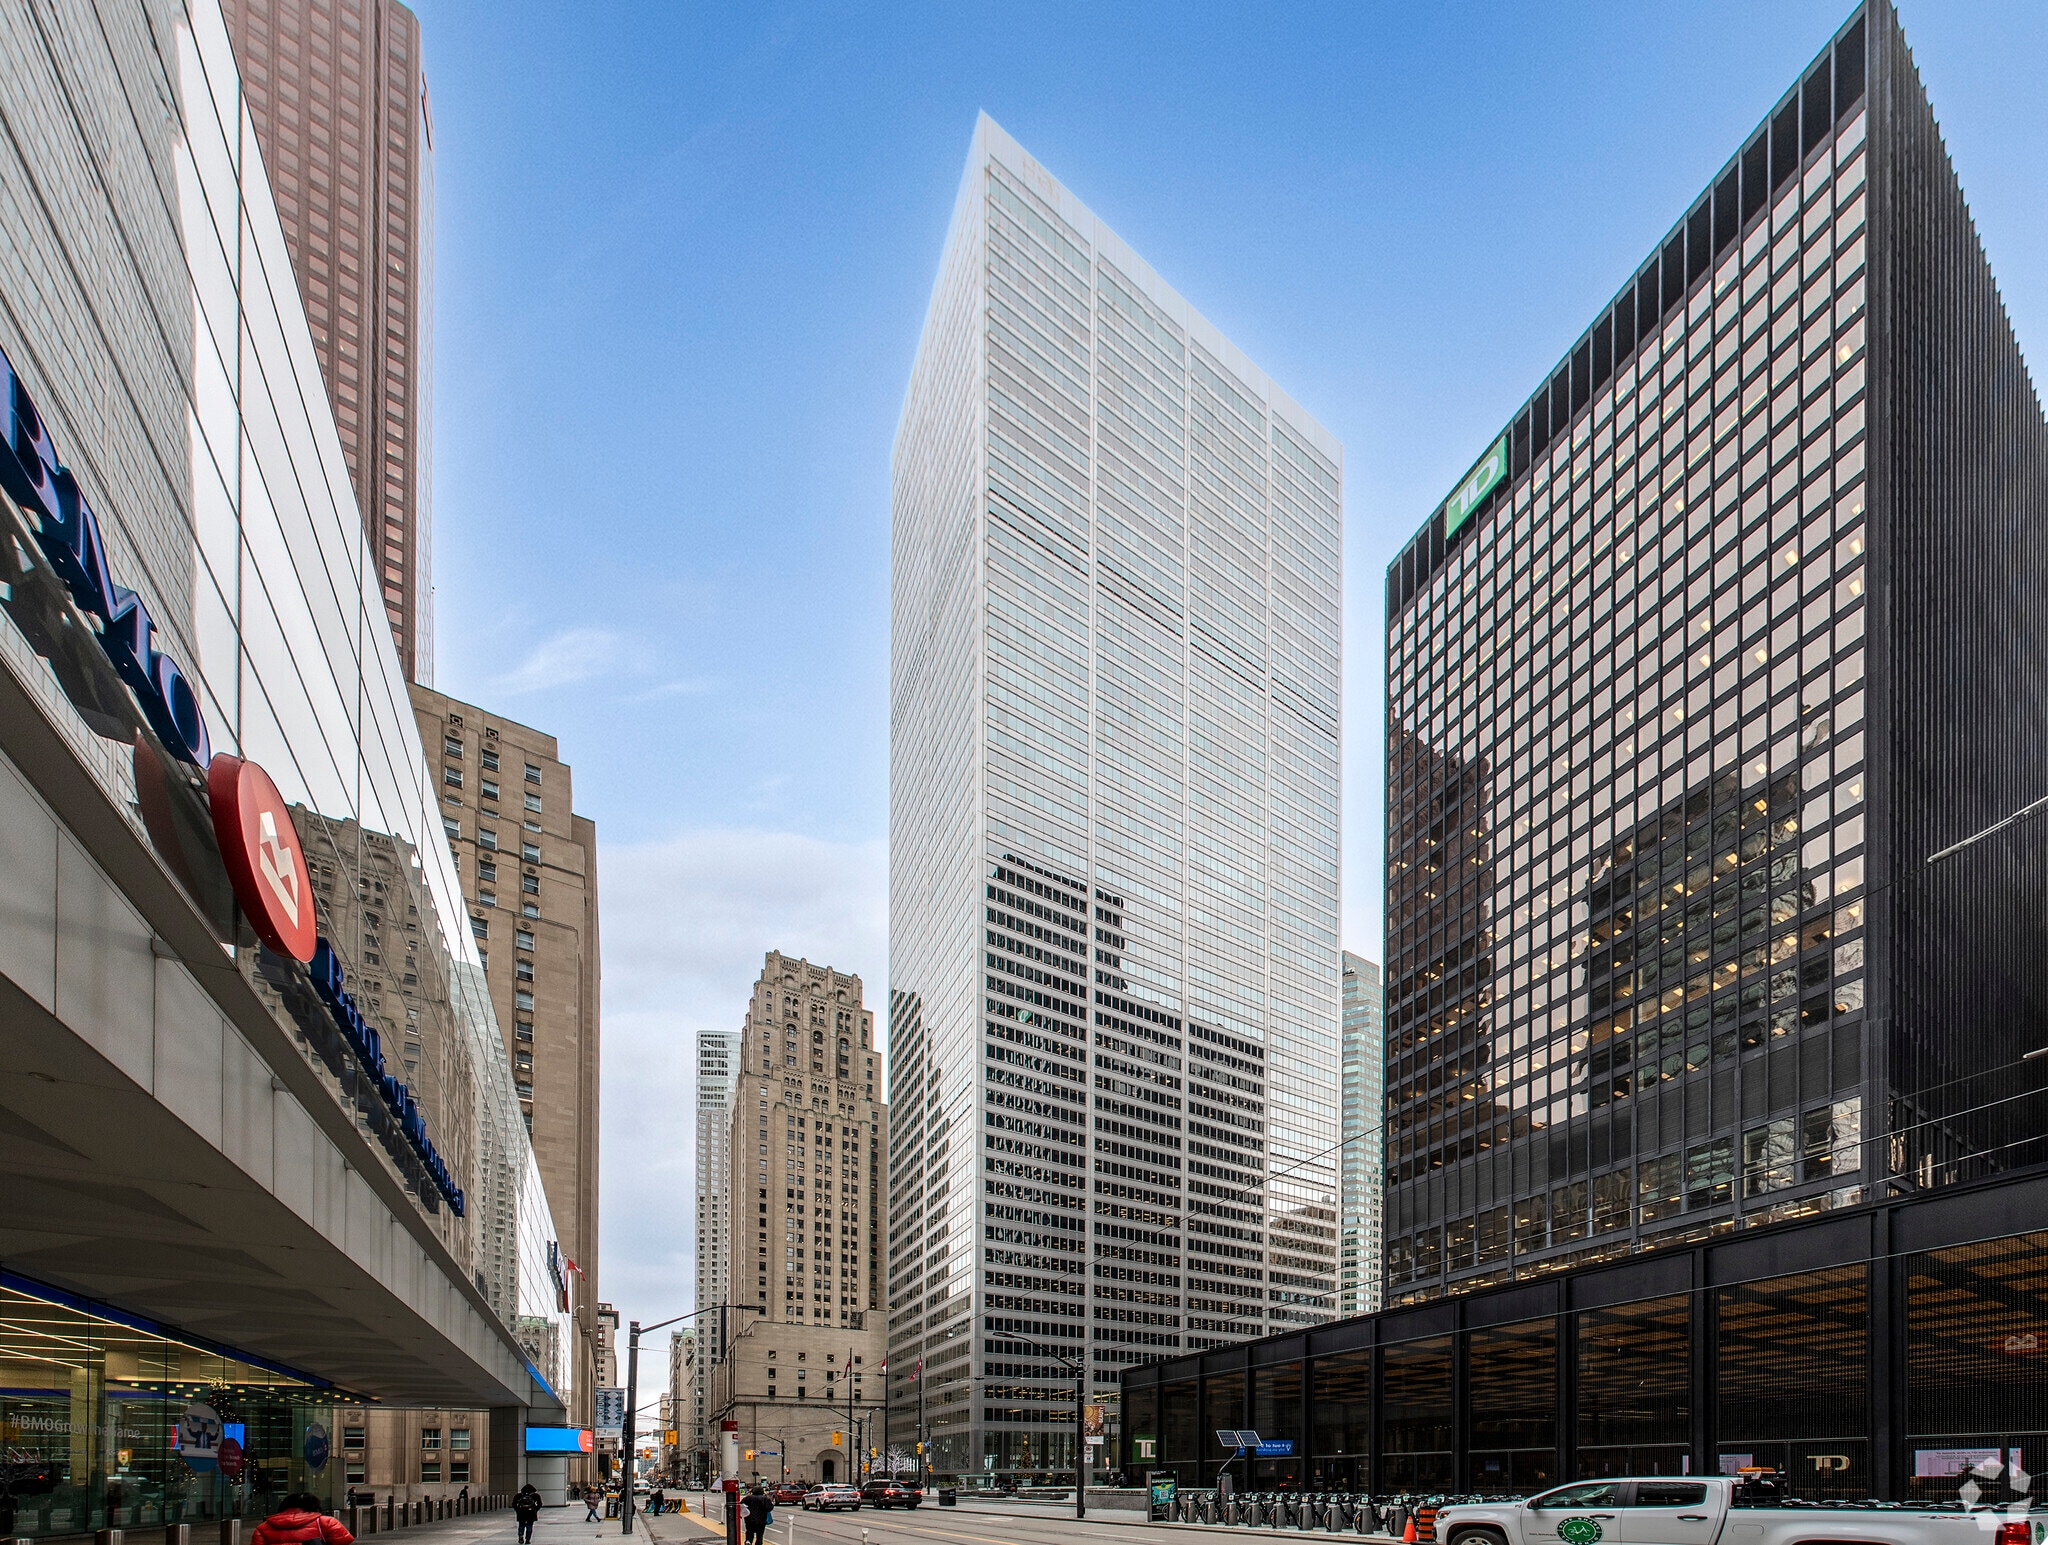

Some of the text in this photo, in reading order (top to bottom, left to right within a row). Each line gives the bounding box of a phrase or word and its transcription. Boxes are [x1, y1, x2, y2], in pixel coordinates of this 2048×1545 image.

[1451, 455, 1500, 515] TD
[0, 345, 211, 770] BMO
[1807, 1455, 1850, 1471] TD
